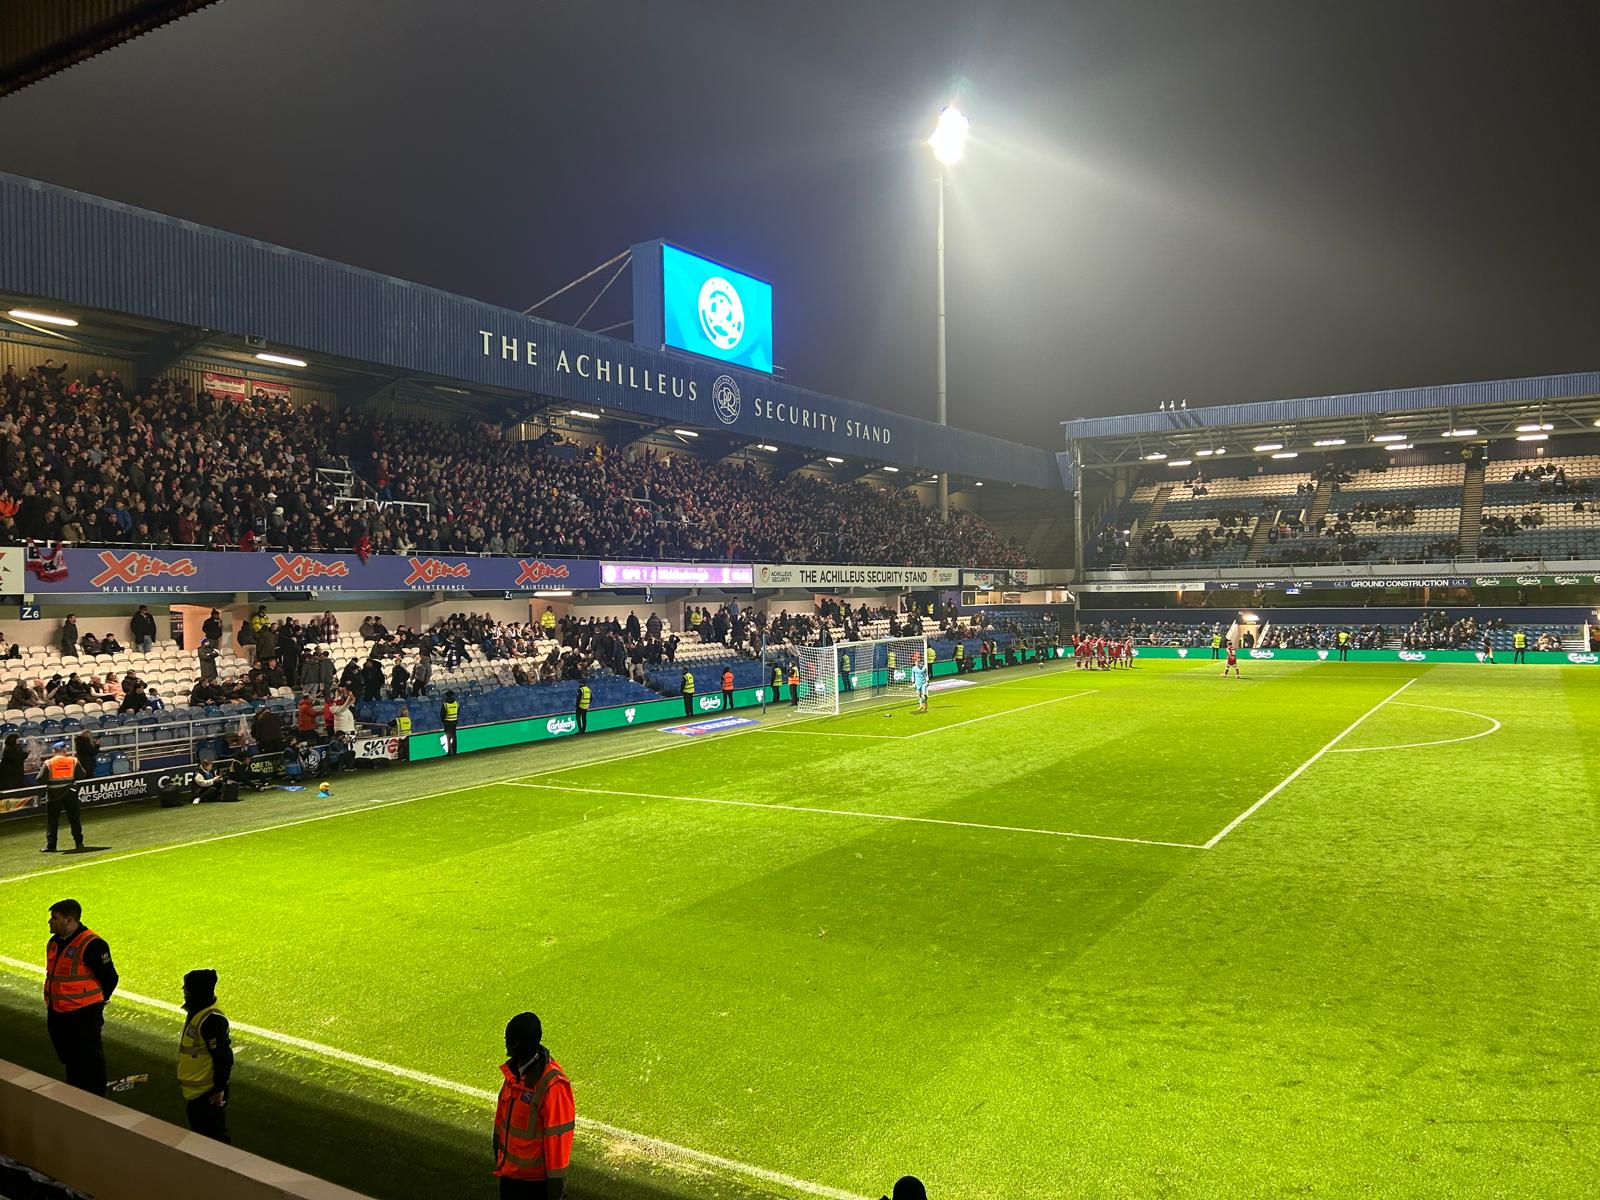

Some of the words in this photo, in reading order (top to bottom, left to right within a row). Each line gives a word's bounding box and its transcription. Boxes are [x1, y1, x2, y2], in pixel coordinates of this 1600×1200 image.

[479, 330, 537, 366] THE
[556, 350, 697, 401] ACHILLEUS
[754, 398, 837, 433] SECURITY
[846, 419, 891, 444] STAND
[90, 550, 197, 587] Xtra
[266, 553, 349, 586] Xtra
[404, 557, 471, 586] Xtra
[515, 559, 569, 586] Xtra
[800, 570, 817, 583] THE
[819, 570, 865, 583] ACHILLEUS
[867, 571, 903, 583] SECURITY
[904, 572, 927, 583] STAND
[103, 585, 188, 593] MAINTENANCE
[1386, 579, 1449, 587] CONSTRUCTION
[700, 696, 721, 710] Carlsberg
[547, 717, 576, 735] Carlsberg
[79, 784, 98, 796] ALL
[100, 777, 147, 793] NATURAL
[92, 789, 123, 802] SPORTS
[123, 786, 148, 798] DRINK
